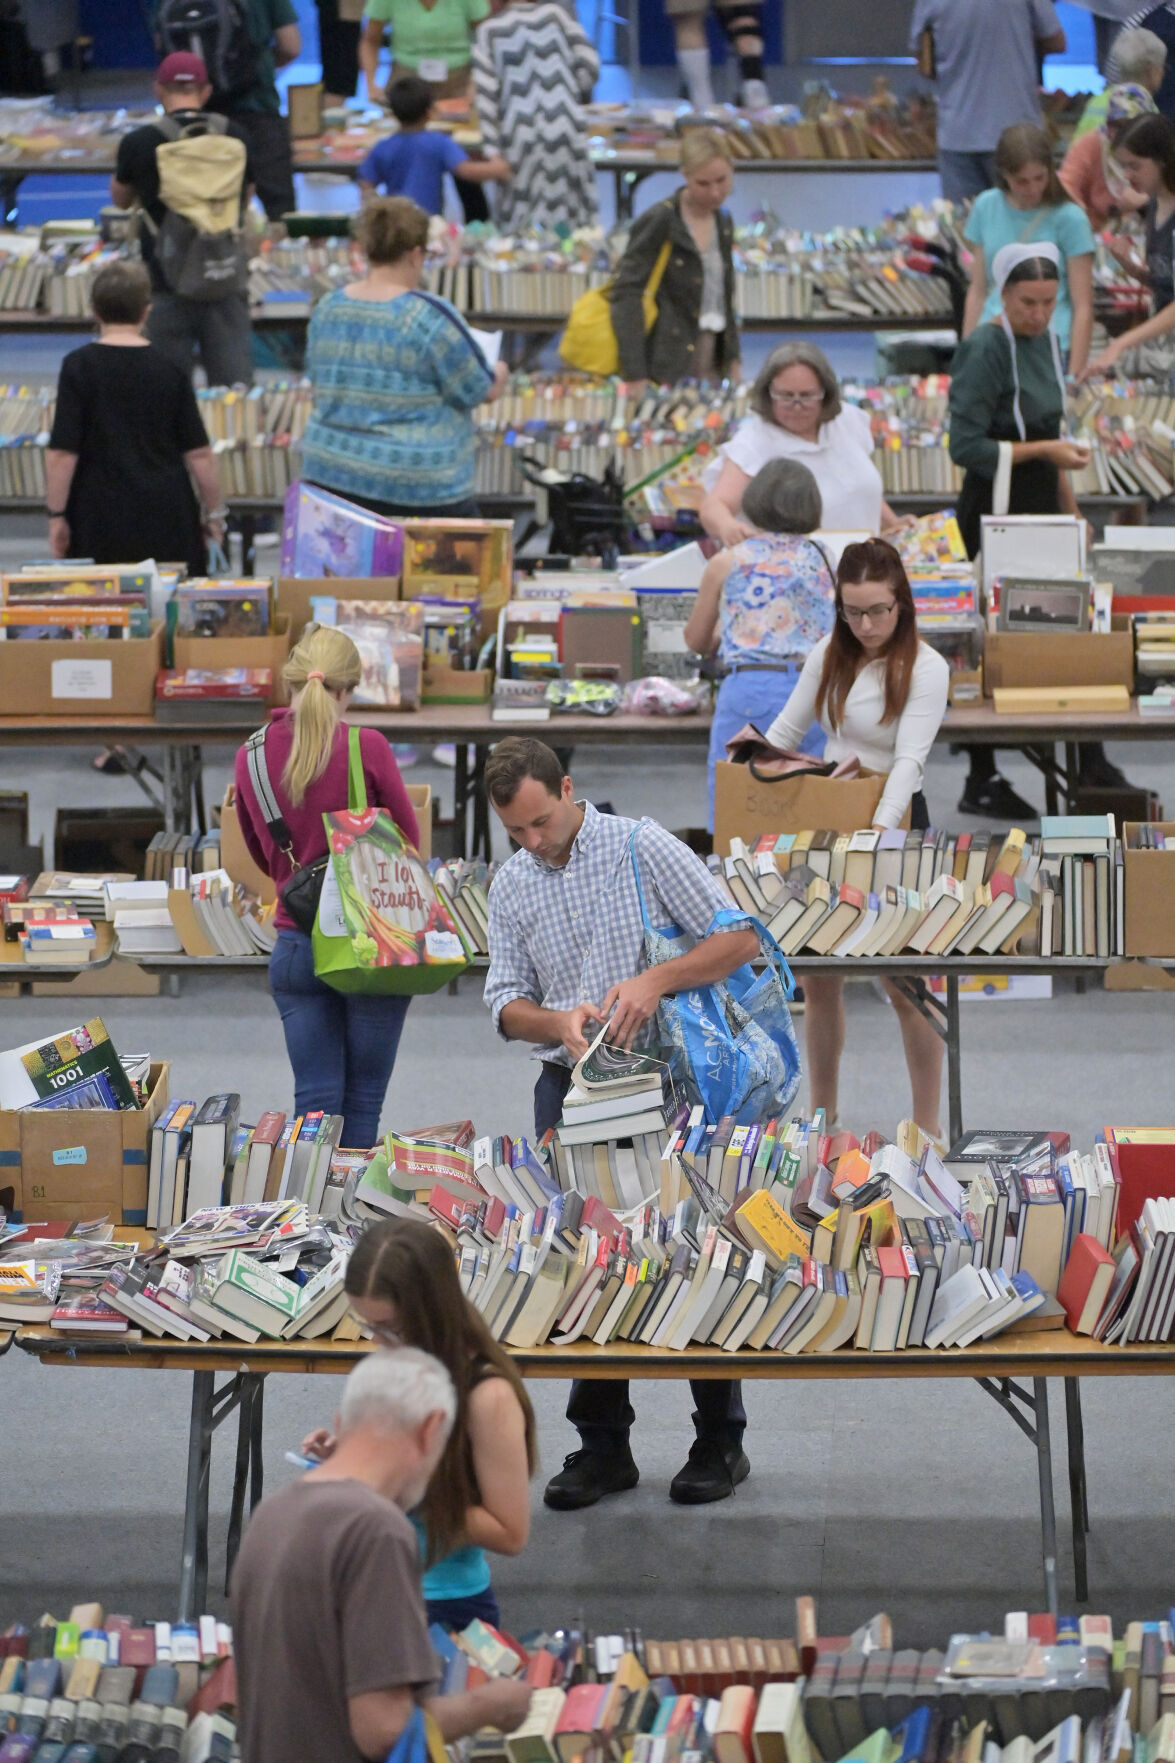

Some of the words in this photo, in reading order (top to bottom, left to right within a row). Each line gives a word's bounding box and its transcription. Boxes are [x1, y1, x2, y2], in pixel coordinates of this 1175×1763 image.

[377, 862, 389, 883] I
[371, 886, 426, 911] Stauff
[46, 1059, 78, 1078] MATHEMATICS
[49, 1065, 84, 1089] 1001
